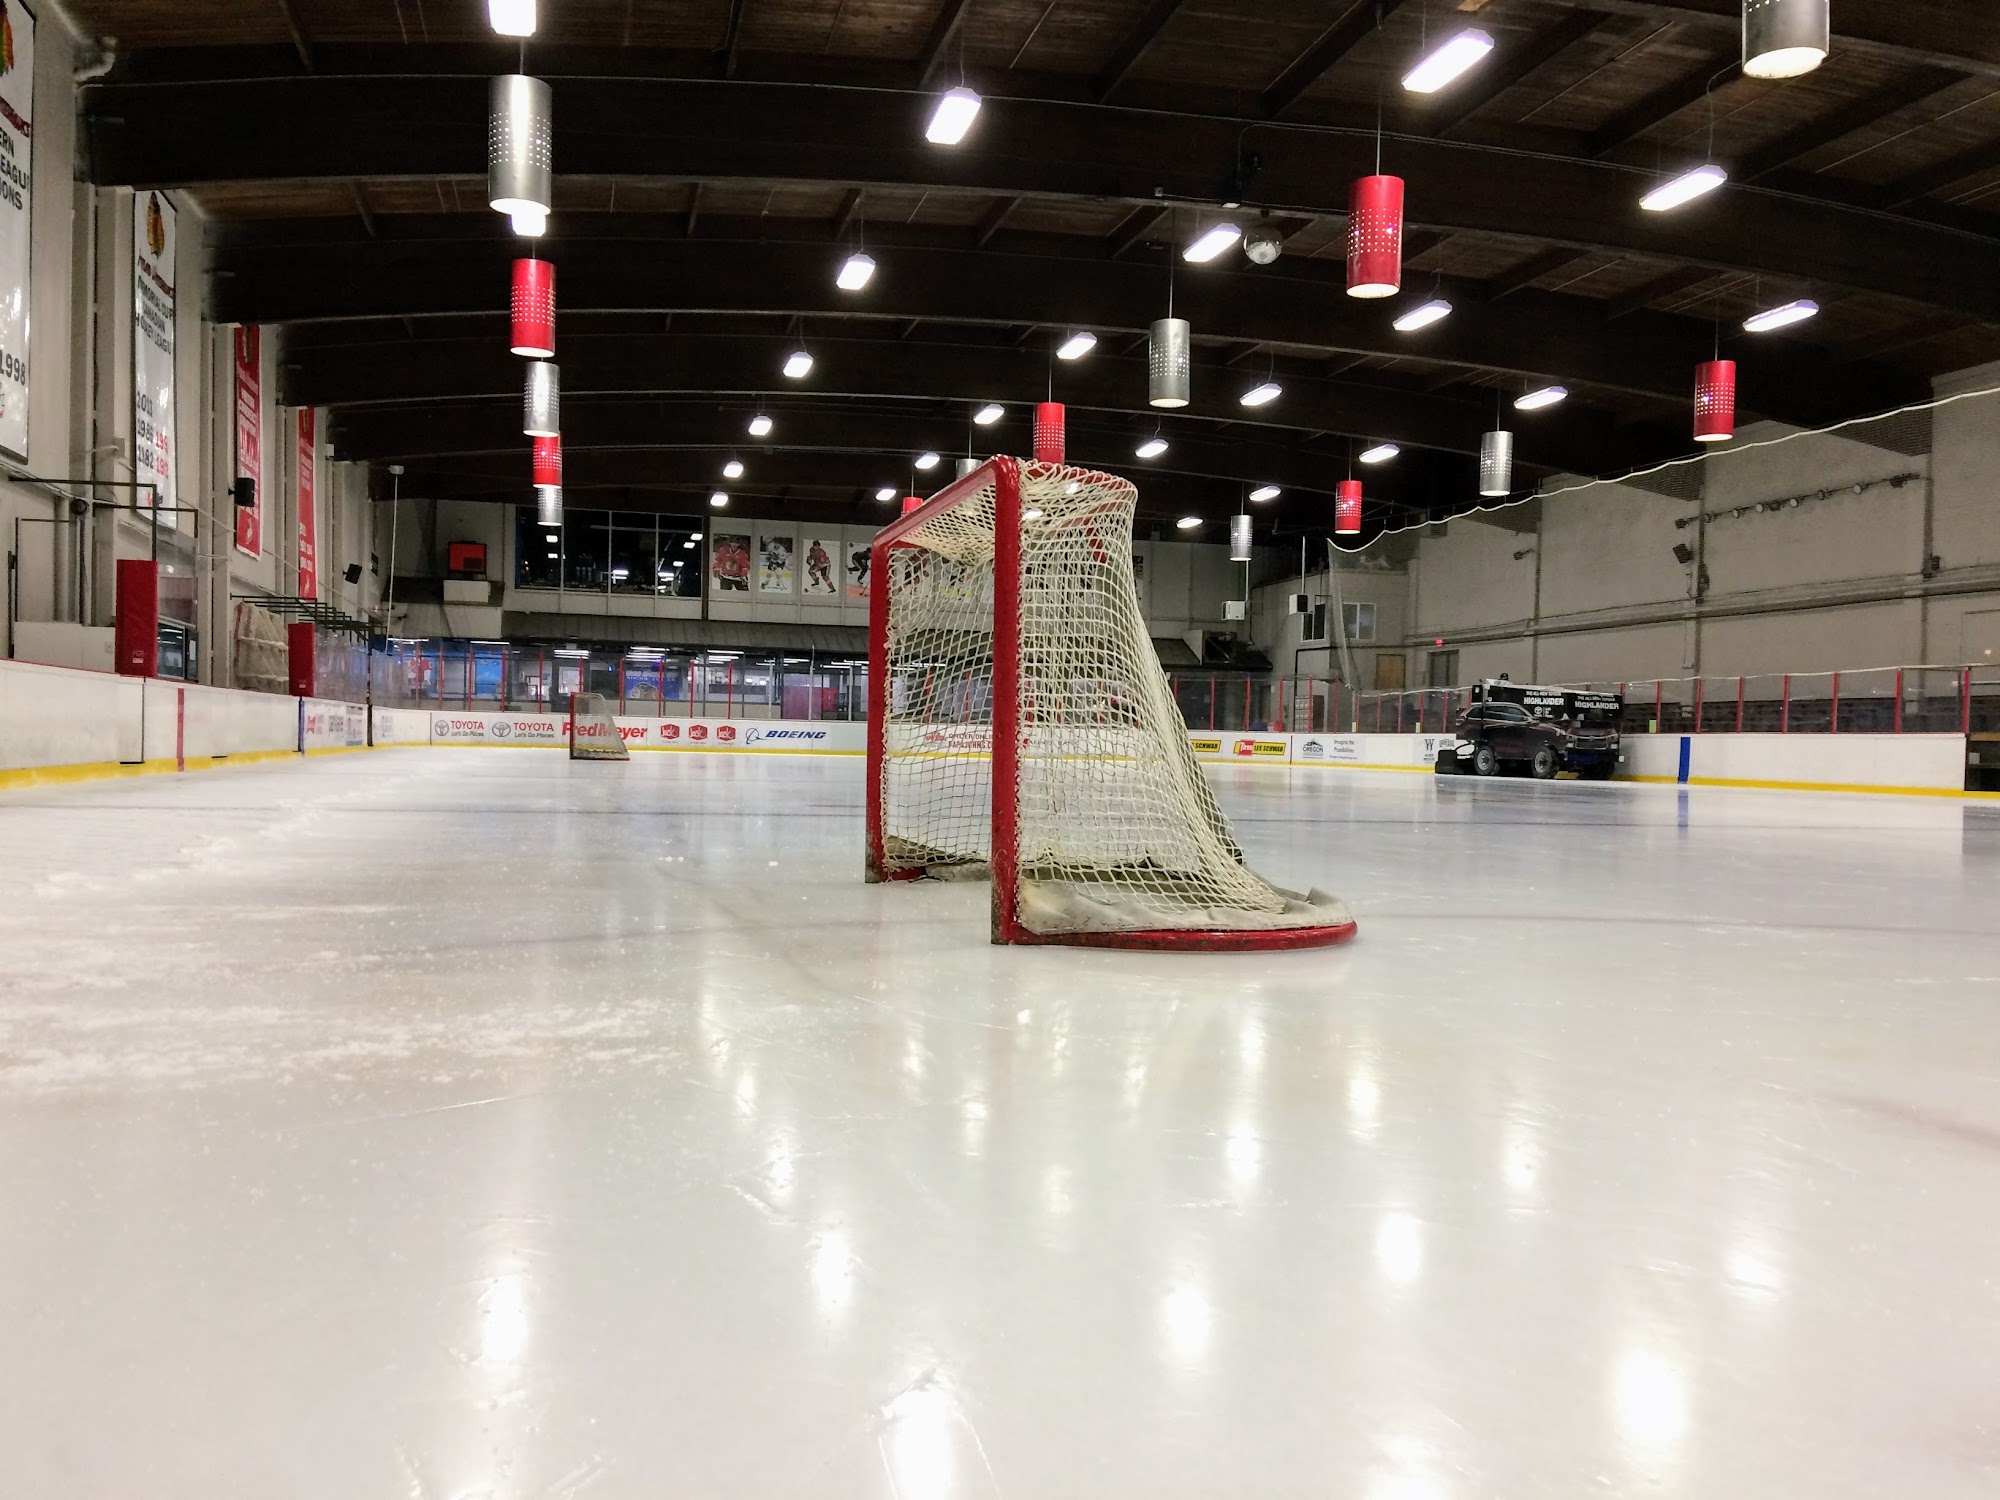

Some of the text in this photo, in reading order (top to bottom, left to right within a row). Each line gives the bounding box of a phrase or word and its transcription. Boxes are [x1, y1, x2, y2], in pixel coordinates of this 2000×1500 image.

[0, 349, 26, 386] 1998
[1524, 697, 1564, 705] HIGHLANDER
[1575, 701, 1619, 709] HIGHLANDER
[451, 721, 484, 730] TOYOTA
[514, 723, 554, 732] TOYOTA
[766, 731, 826, 739] BOEING
